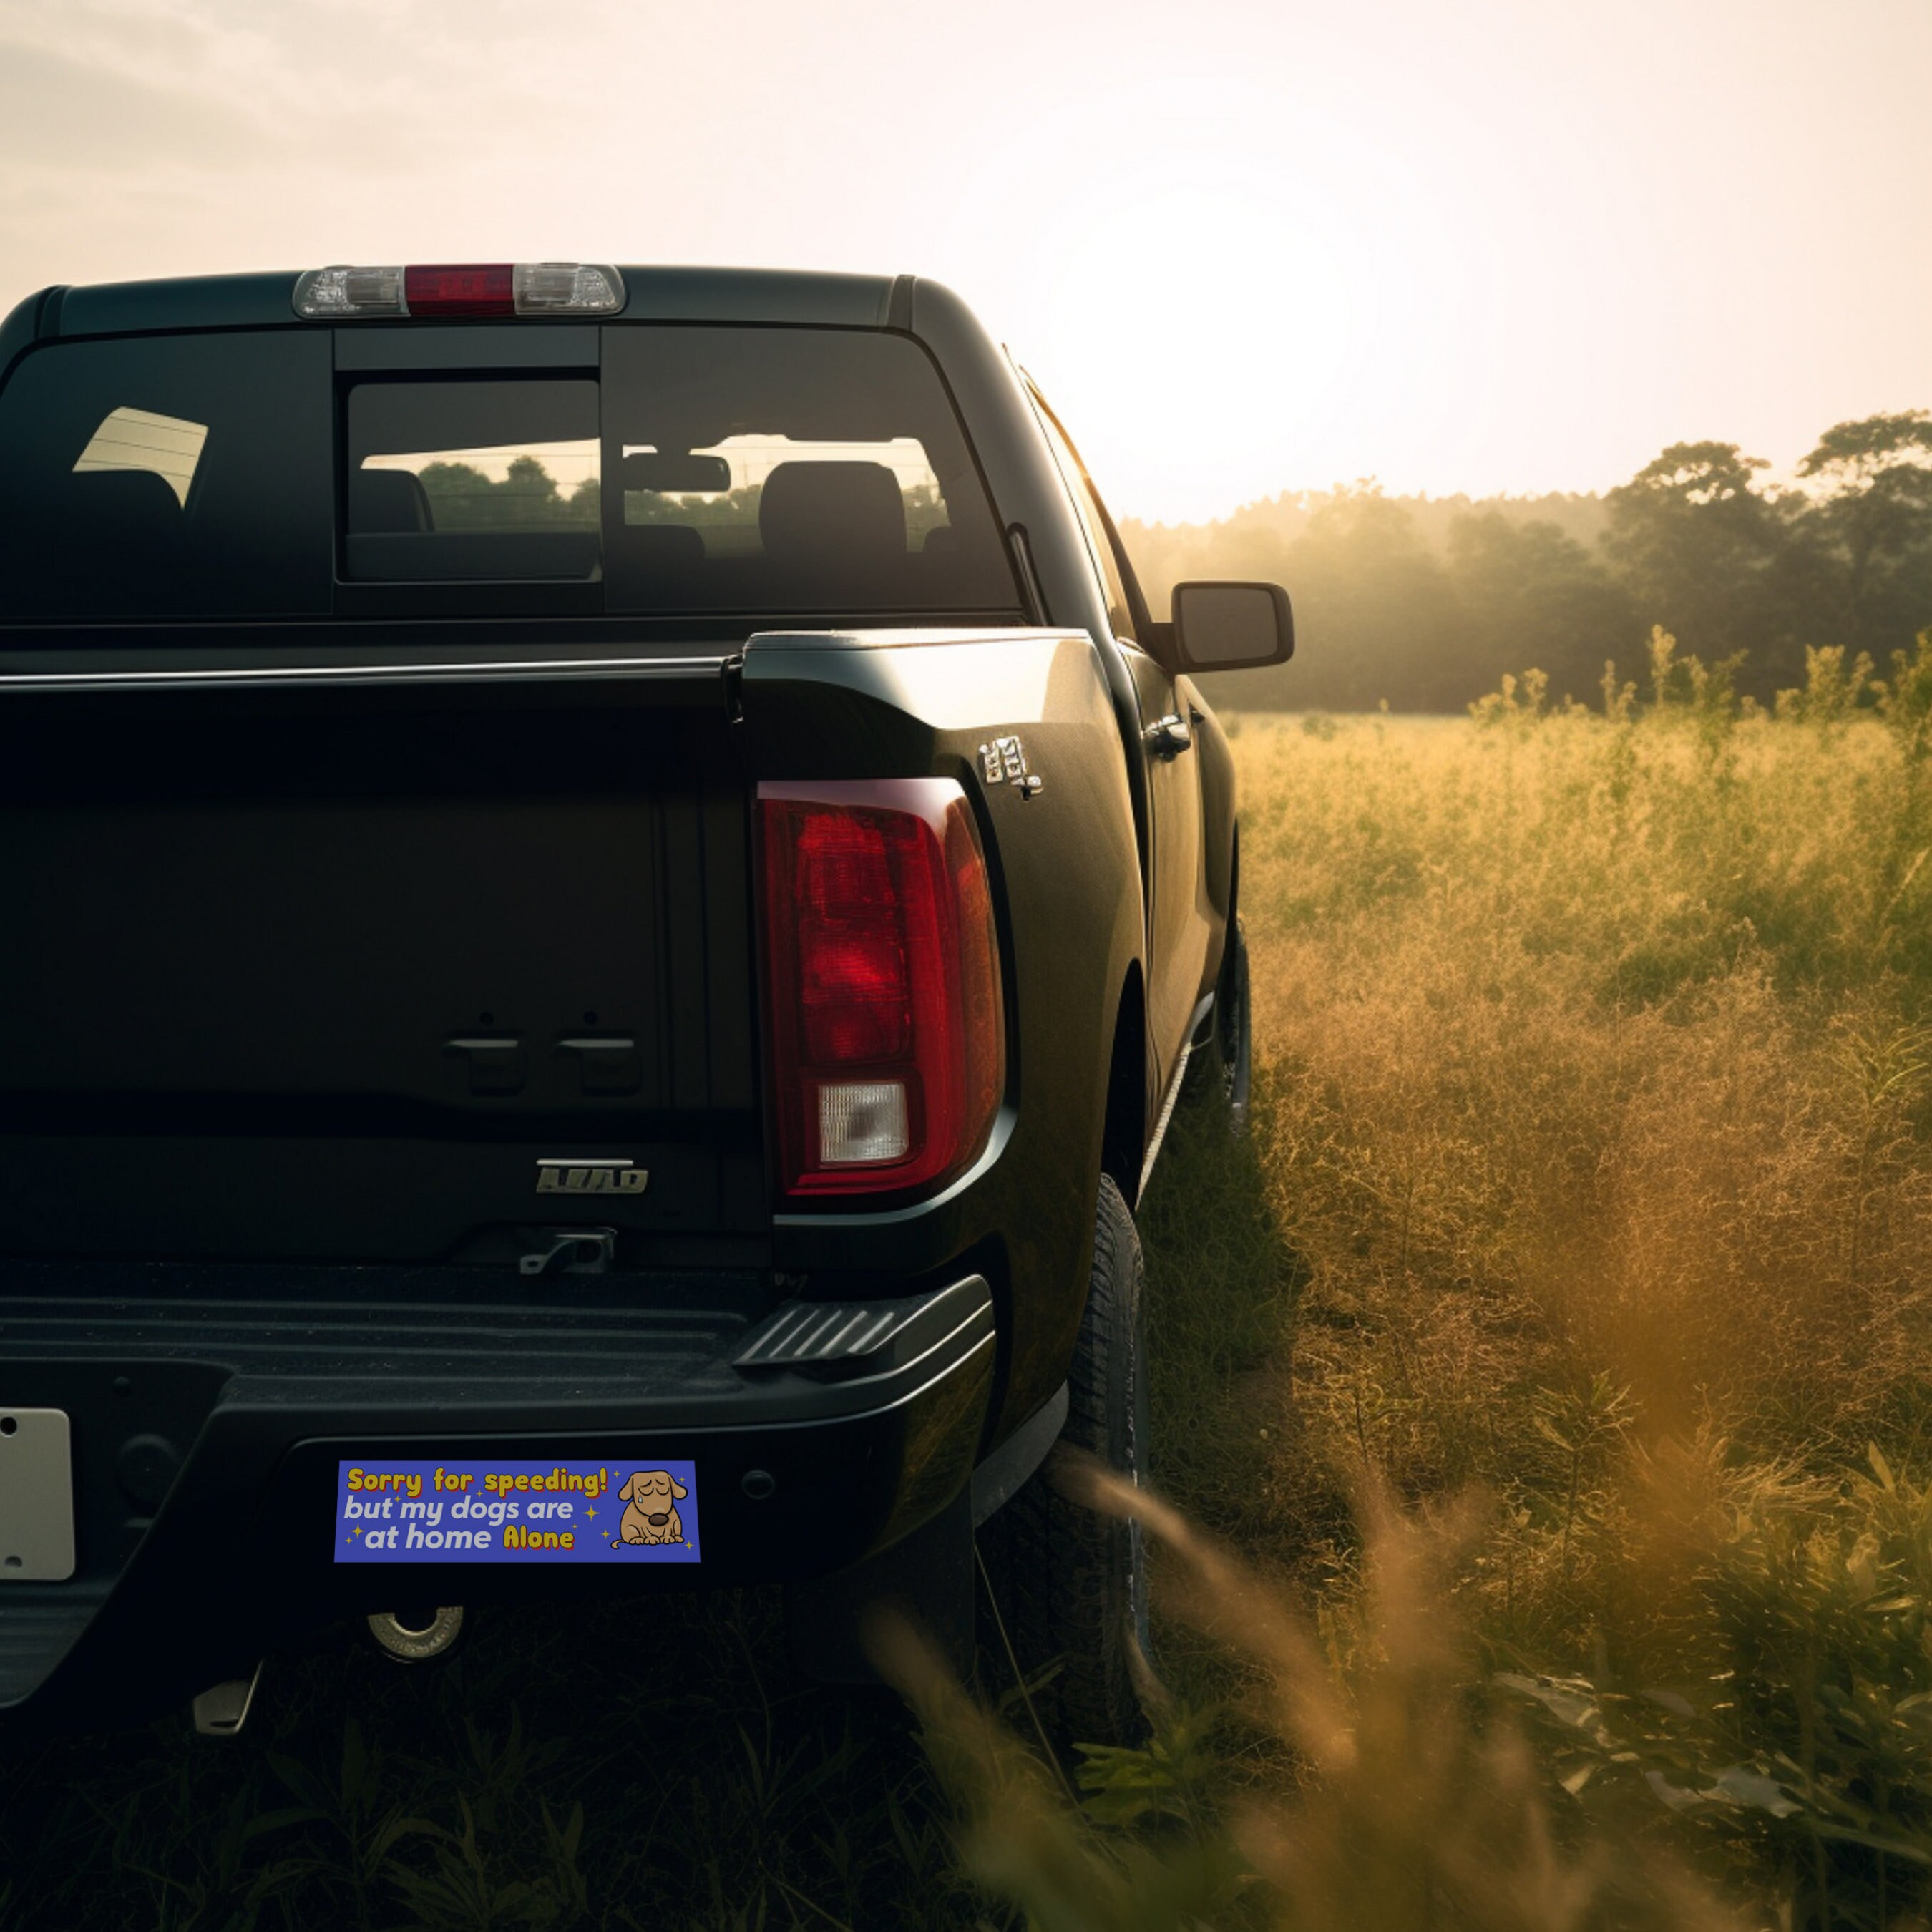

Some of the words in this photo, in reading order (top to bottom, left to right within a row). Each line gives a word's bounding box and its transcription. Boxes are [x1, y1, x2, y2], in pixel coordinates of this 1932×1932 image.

[347, 1467, 422, 1498] Sorry
[433, 1467, 474, 1492] for
[484, 1467, 608, 1498] speeding!
[343, 1495, 391, 1519] but
[399, 1502, 444, 1526] my
[451, 1495, 519, 1526] dogs
[527, 1502, 573, 1519] are
[364, 1526, 399, 1549] at
[405, 1523, 492, 1549] home
[503, 1525, 575, 1550] Alone
